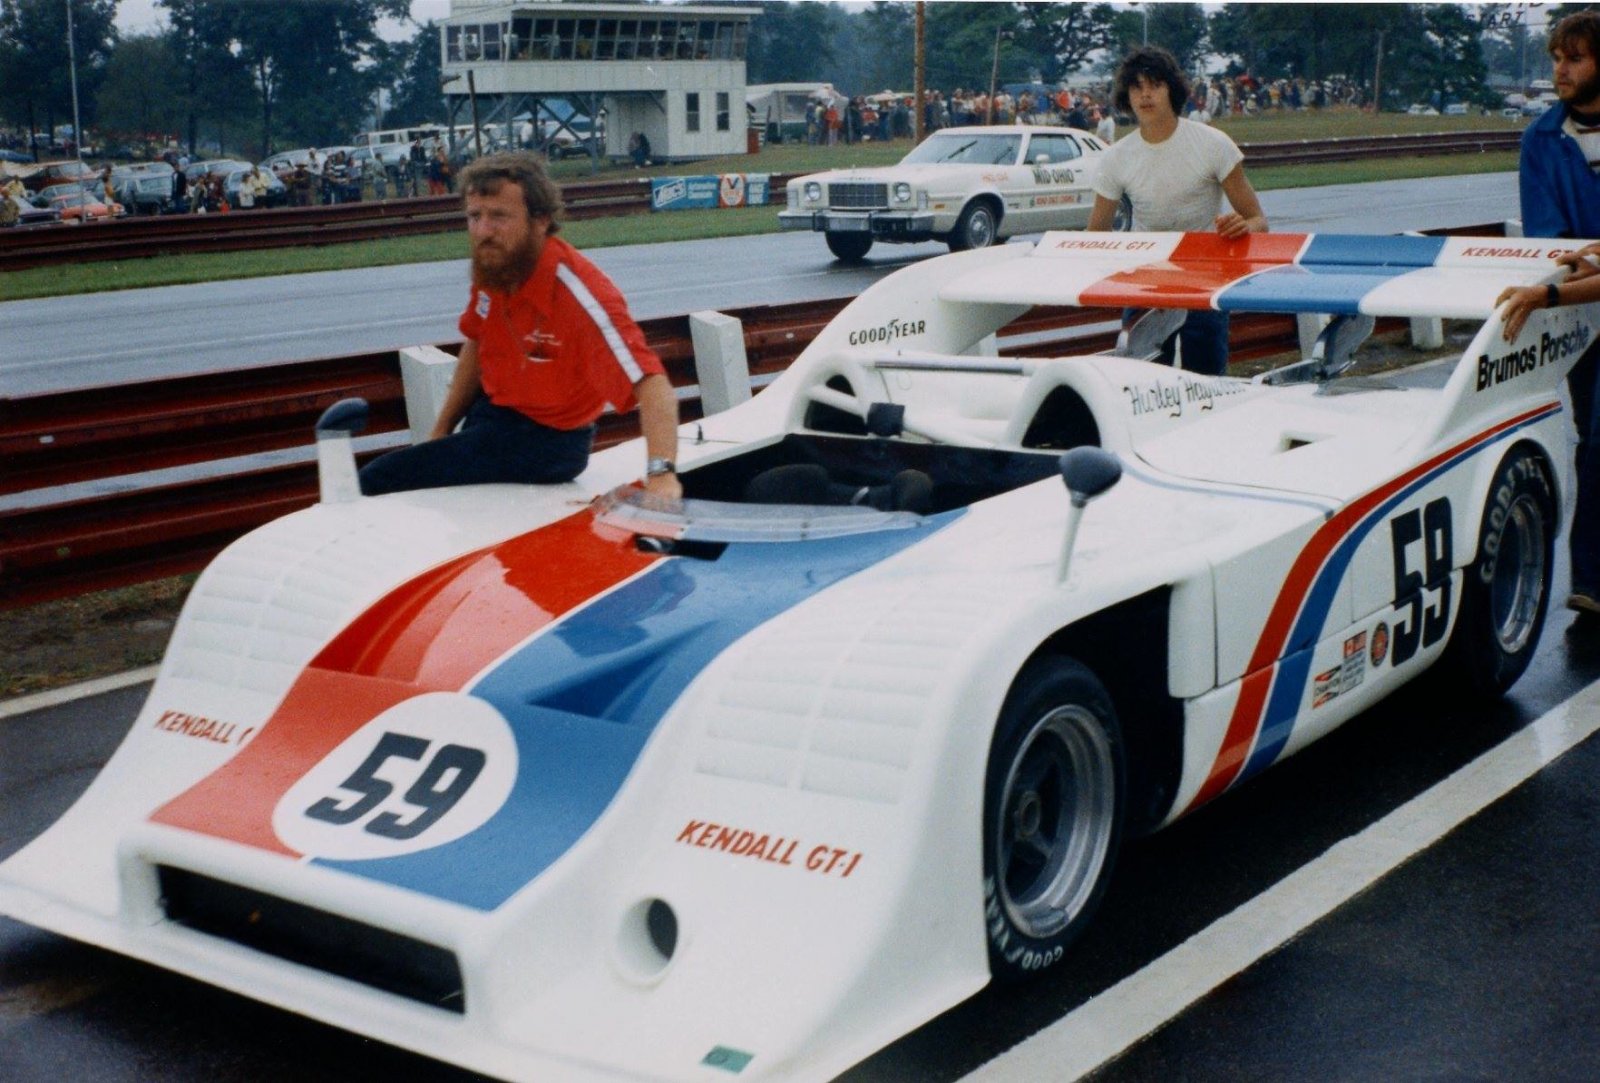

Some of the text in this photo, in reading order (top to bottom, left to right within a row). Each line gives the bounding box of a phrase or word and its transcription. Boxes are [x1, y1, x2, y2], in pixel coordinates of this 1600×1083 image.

[1032, 170, 1051, 185] MID
[1055, 240, 1121, 249] KENDALL
[1462, 247, 1541, 258] KENDALL
[849, 319, 926, 346] GOODYEAR
[1477, 320, 1588, 392] Brumos Porsche
[1391, 496, 1453, 668] 59
[154, 710, 236, 744] KENDALL
[305, 731, 486, 840] 59
[676, 819, 799, 866] KENDALL
